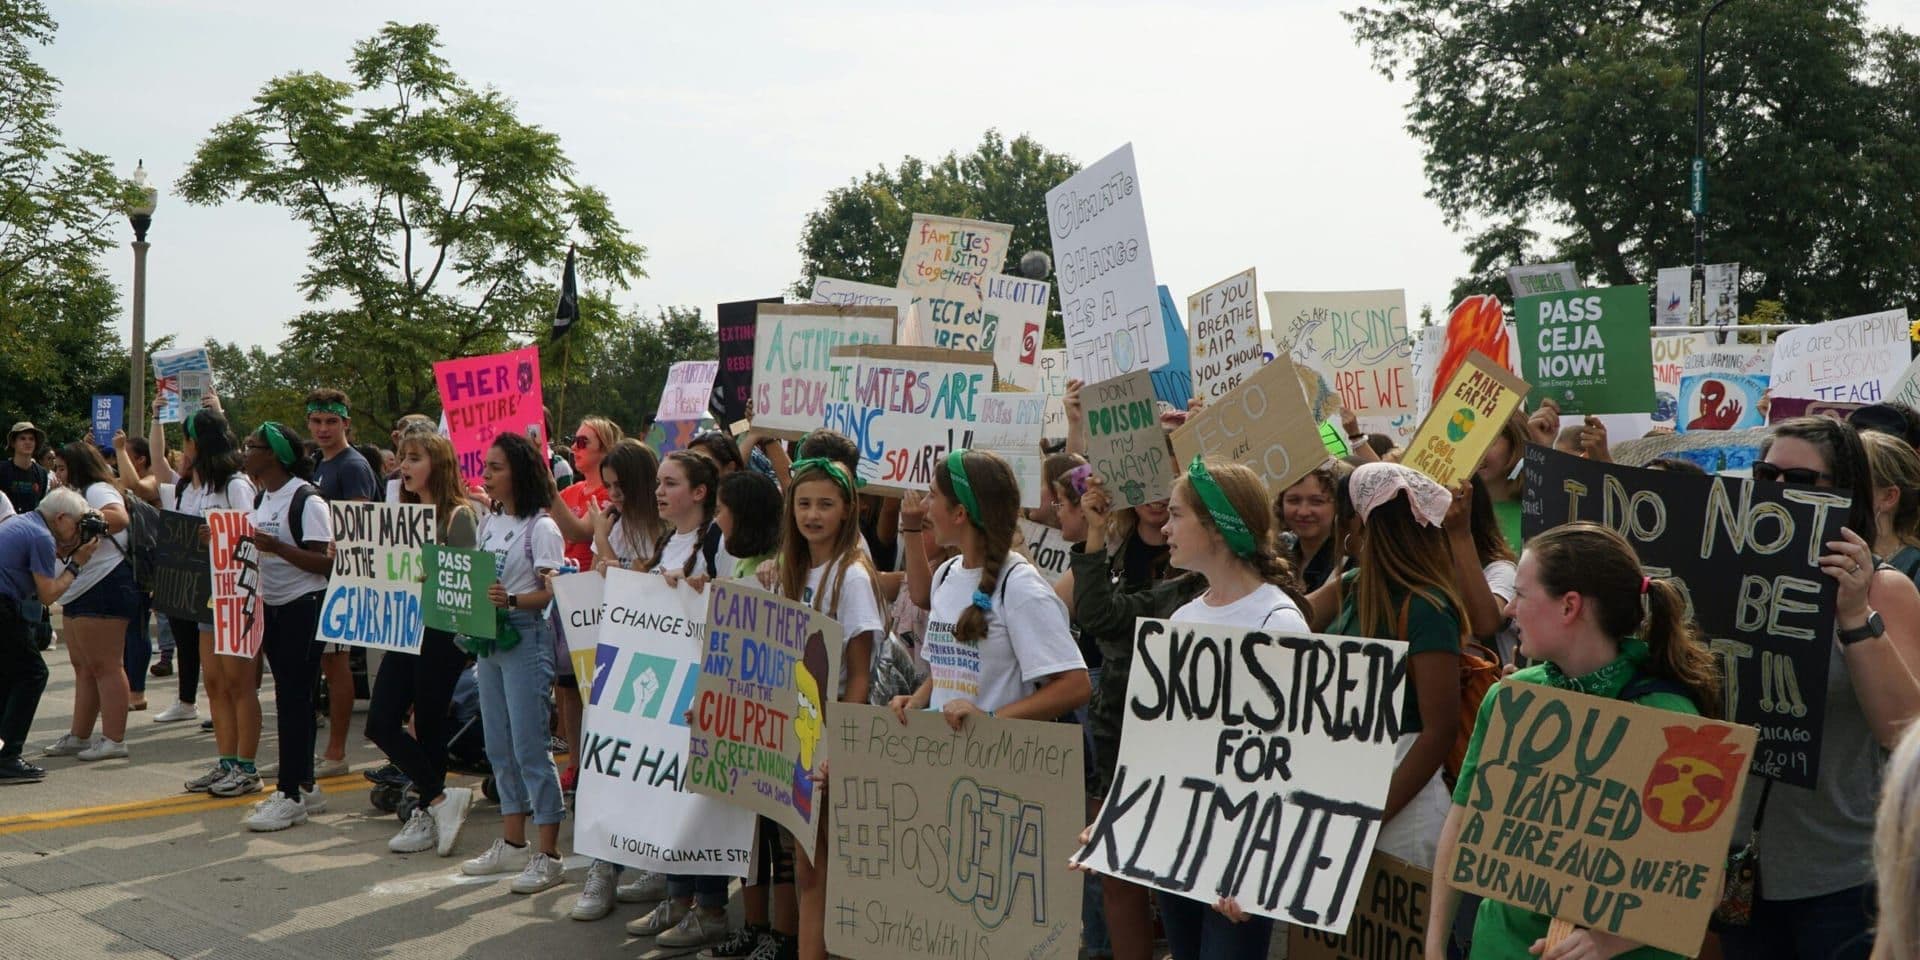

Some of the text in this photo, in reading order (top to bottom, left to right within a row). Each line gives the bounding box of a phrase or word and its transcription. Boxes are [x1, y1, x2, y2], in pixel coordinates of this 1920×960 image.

[1692, 160, 1703, 212] C1121
[1101, 290, 1117, 321] A
[1201, 279, 1249, 317] IF YOU
[1538, 296, 1604, 326] PASS
[1197, 300, 1254, 340] BREATHE
[1331, 306, 1409, 352] RISING
[1834, 314, 1909, 353] SKIPPING
[1208, 329, 1236, 359] AIR
[1537, 325, 1605, 353] CEJA
[445, 365, 510, 401] HER
[1196, 361, 1221, 387] YOU
[1538, 353, 1605, 379] NOW!
[1594, 377, 1608, 385] Act
[756, 382, 772, 416] IS
[830, 364, 984, 423] THE WATERS ARE
[1335, 368, 1408, 410] ARE WE
[1454, 381, 1498, 419] EARTH
[1467, 369, 1506, 402] MAKE
[1813, 378, 1883, 401] TEACH
[823, 402, 885, 461] RISING
[1088, 399, 1154, 436] POISON
[1196, 384, 1269, 458] ECO
[881, 447, 909, 483] SO
[1097, 447, 1163, 485] SWAMP
[1426, 434, 1458, 465] COOL
[1413, 448, 1458, 489] AGAIN
[333, 504, 434, 549] DONT MAKE
[1563, 475, 1853, 567] I DO NOT
[335, 548, 351, 577] US
[350, 547, 376, 579] THE
[438, 551, 472, 573] PASS
[214, 571, 238, 597] THE
[436, 589, 472, 609] NOW!
[438, 570, 472, 592] CEJA
[321, 584, 424, 649] GENERATION
[610, 606, 684, 635] CHANGE
[1735, 574, 1822, 641] BE
[709, 631, 730, 653] BE
[928, 620, 956, 634] STRIKES
[703, 637, 796, 690] ANY DOUBT
[928, 642, 955, 656] STRIKES
[956, 647, 980, 660] BACK
[930, 654, 956, 667] STRIKES
[957, 658, 980, 673] BACK
[727, 677, 774, 703] THAT THE
[1131, 620, 1409, 745] SKOLSTREJK
[699, 690, 789, 753] CULPRIT
[1498, 685, 1631, 776] YOU
[690, 736, 709, 758] IS
[1216, 729, 1292, 783] FÖR
[1764, 749, 1807, 777] 2019
[1470, 758, 1643, 841] STARTED
[610, 833, 618, 848] IL
[622, 836, 659, 859] YOUTH
[662, 849, 722, 862] CLIMATE
[1077, 764, 1385, 927] KLIMATET
[1458, 811, 1710, 899] A FIRE AND WE'RE
[1370, 867, 1427, 935] ARE
[1582, 884, 1643, 933] UP
